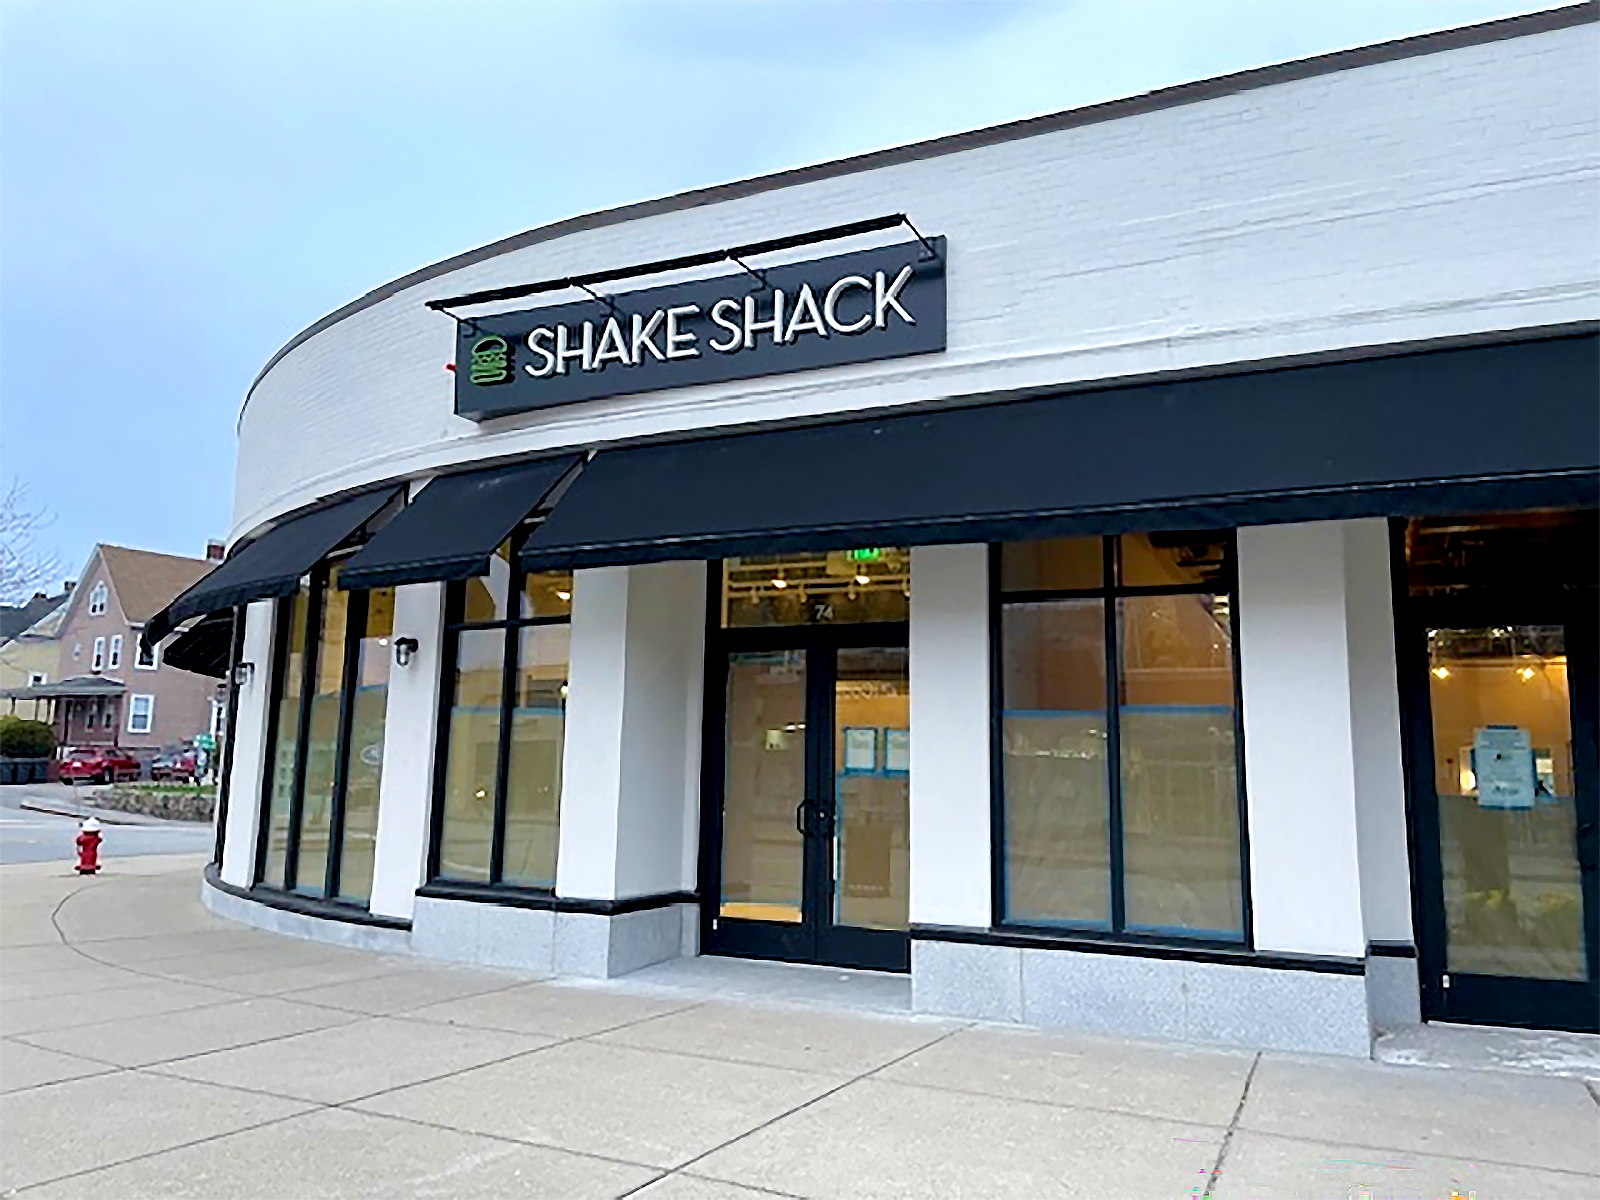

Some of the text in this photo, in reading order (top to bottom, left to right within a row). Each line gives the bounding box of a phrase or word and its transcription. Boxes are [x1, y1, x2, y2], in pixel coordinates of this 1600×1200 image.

[525, 265, 916, 377] SHAKE SHACK
[815, 604, 833, 620] 74
